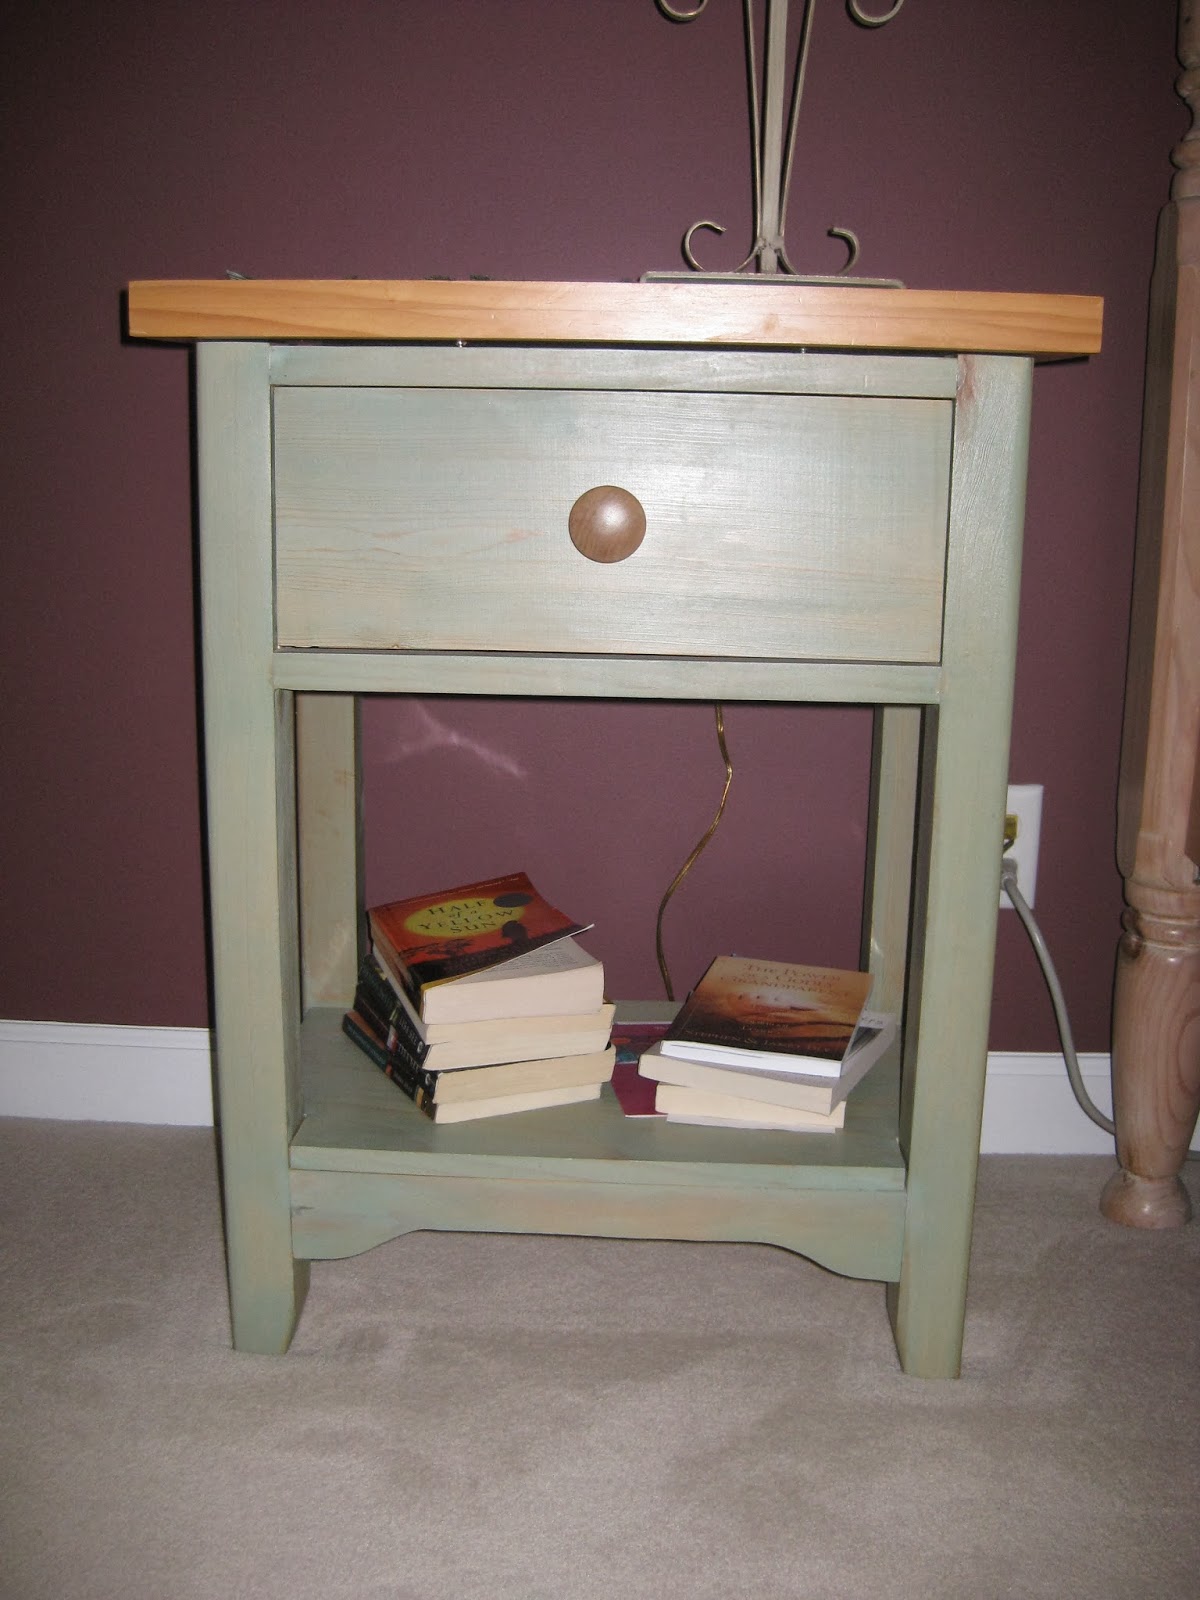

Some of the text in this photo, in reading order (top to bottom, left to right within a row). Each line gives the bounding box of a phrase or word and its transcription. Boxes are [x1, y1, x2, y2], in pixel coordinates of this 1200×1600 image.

[428, 901, 485, 915] HALF
[418, 910, 513, 930] YELLOW
[450, 920, 496, 934] SUN
